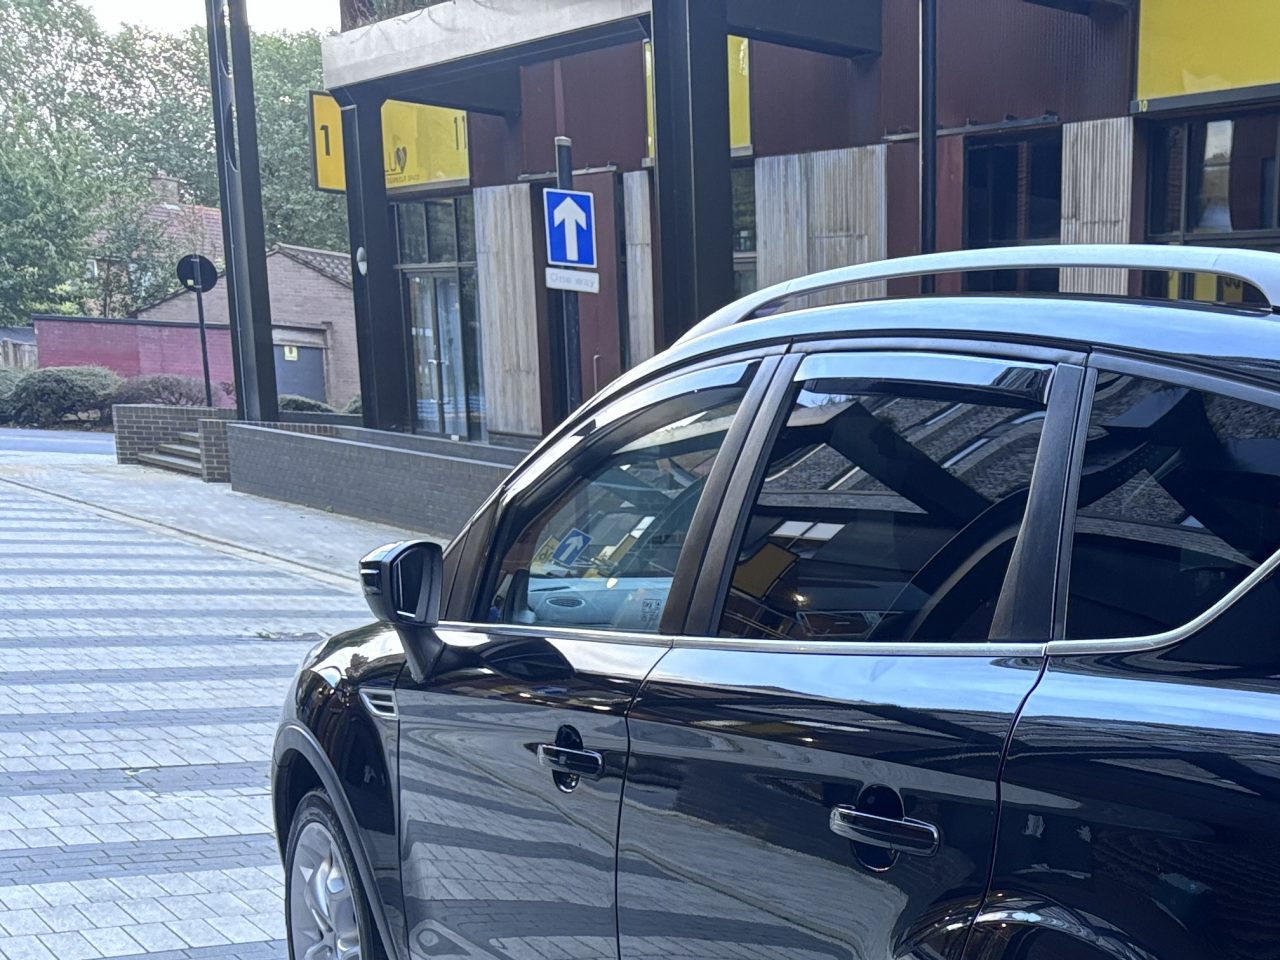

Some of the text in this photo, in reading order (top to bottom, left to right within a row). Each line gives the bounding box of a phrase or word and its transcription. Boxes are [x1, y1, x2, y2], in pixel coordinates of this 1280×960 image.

[1138, 100, 1148, 113] 10
[550, 272, 595, 288] One way
